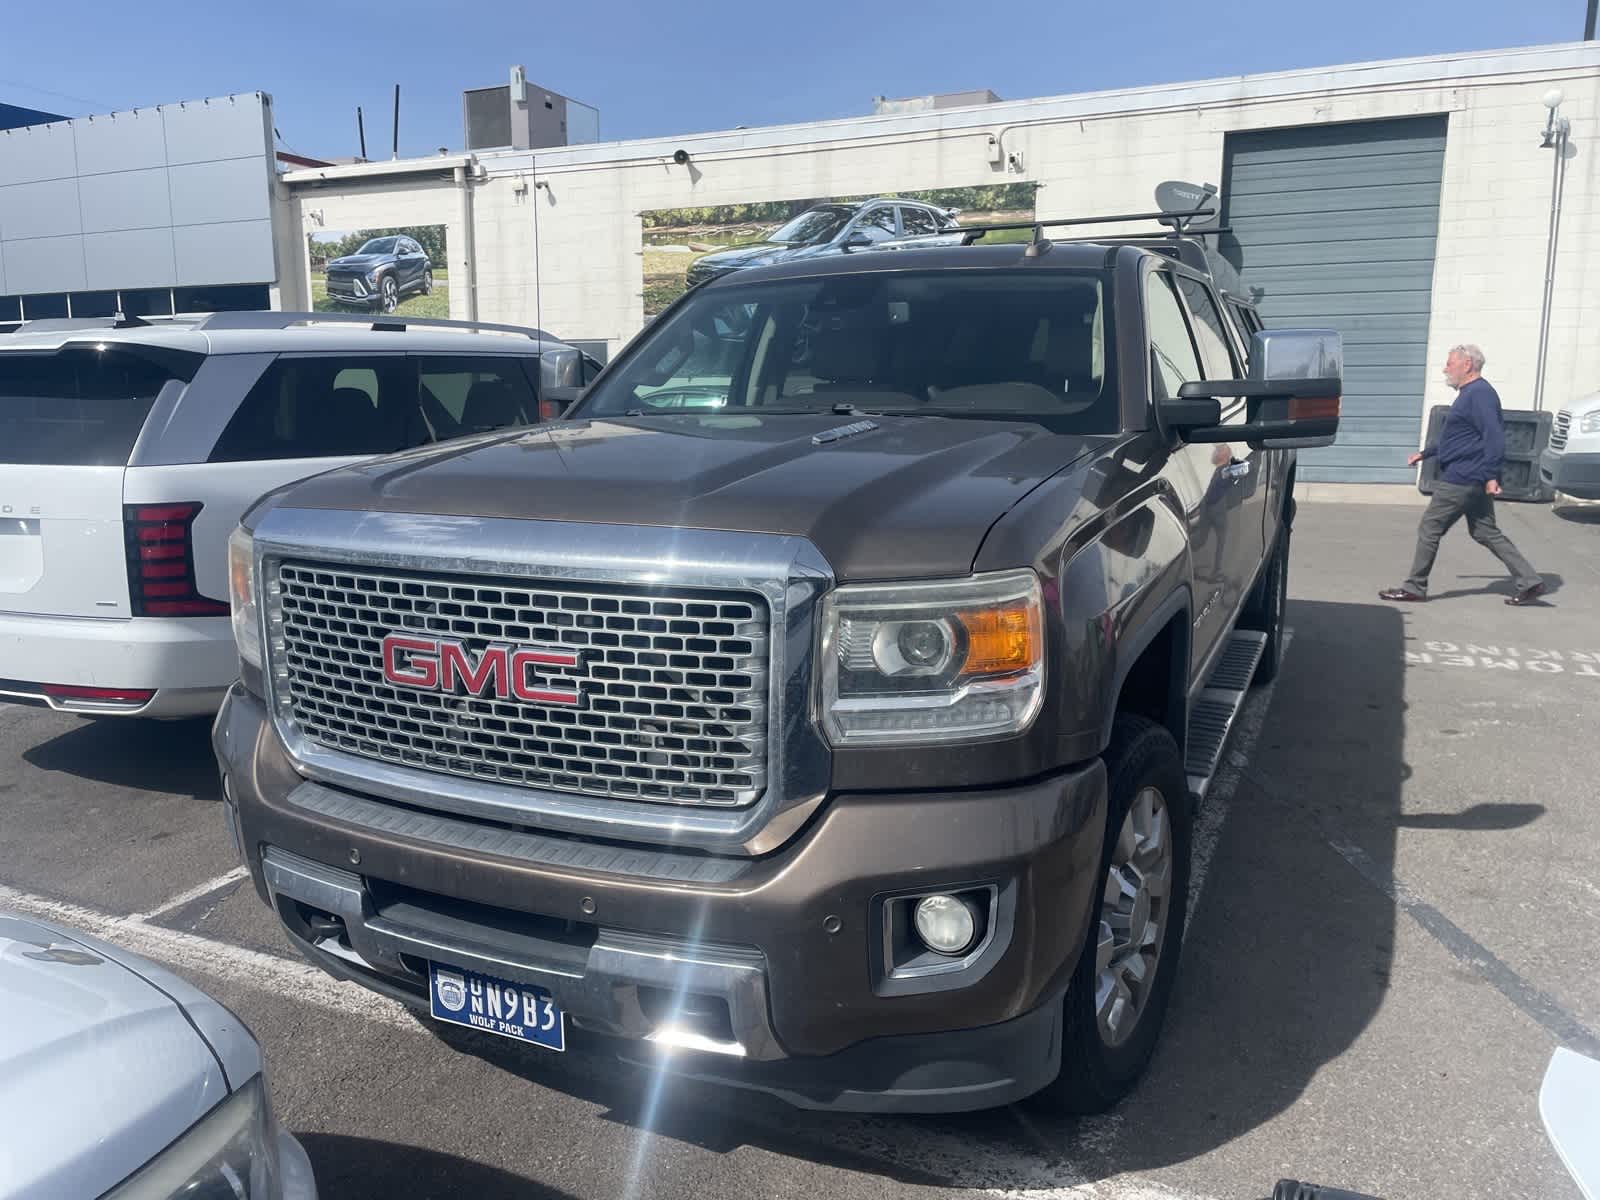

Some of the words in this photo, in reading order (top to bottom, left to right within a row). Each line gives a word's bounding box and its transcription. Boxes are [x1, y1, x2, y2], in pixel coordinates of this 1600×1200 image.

[383, 631, 582, 706] GMC
[469, 1014, 496, 1028] WOLF
[499, 1021, 524, 1037] PACK
